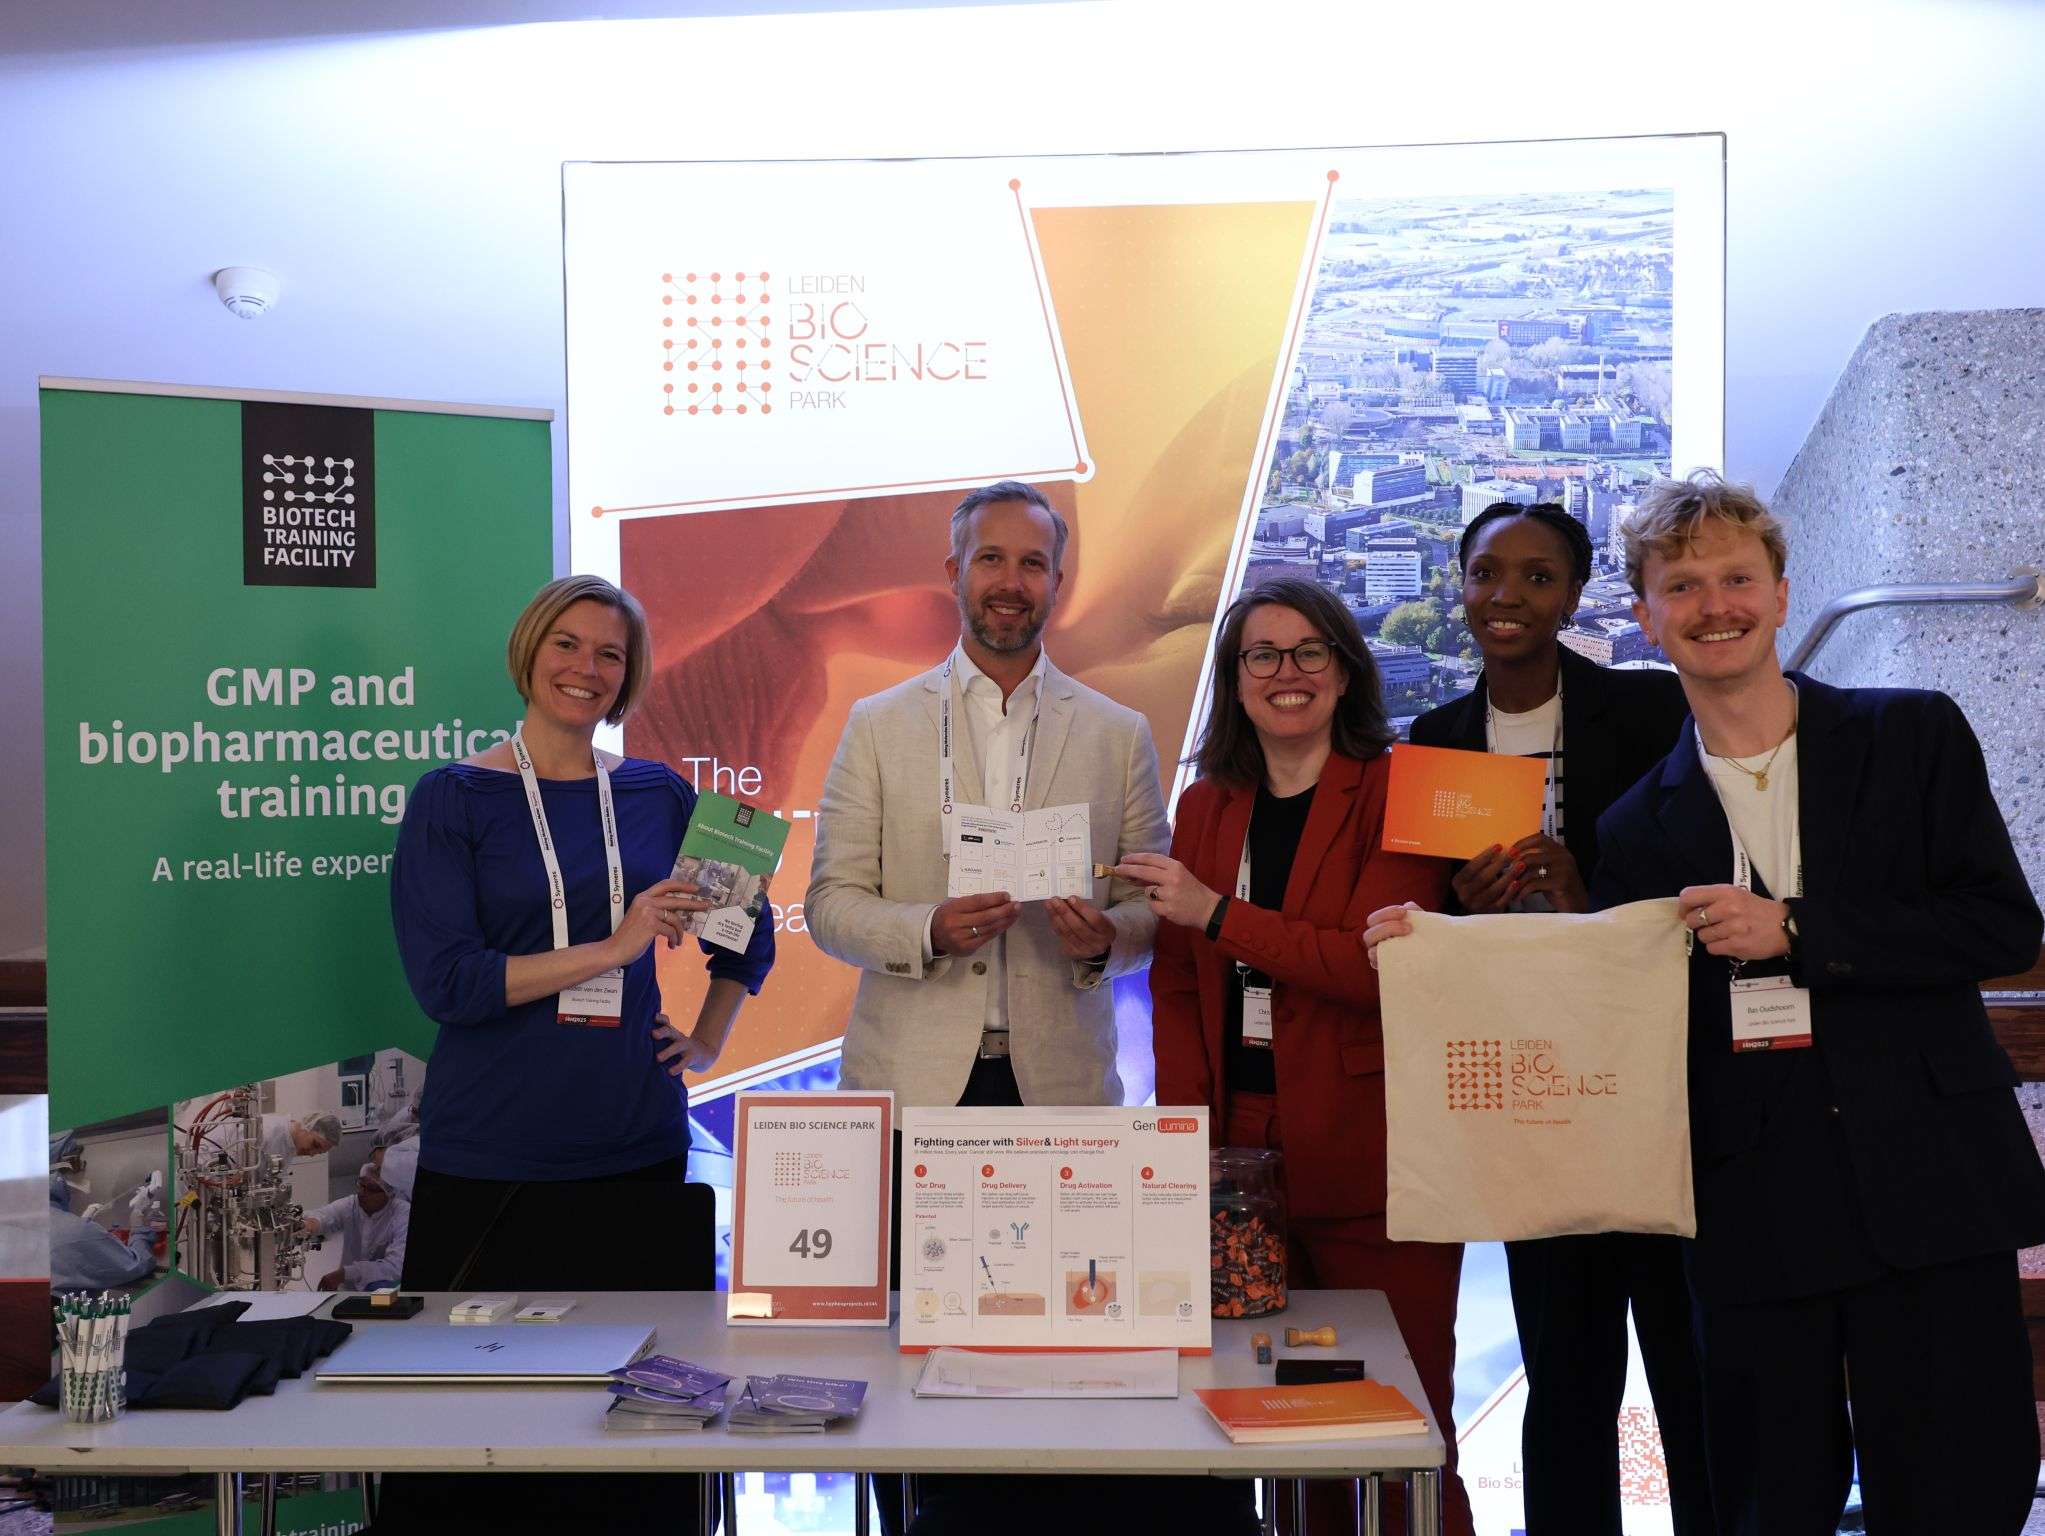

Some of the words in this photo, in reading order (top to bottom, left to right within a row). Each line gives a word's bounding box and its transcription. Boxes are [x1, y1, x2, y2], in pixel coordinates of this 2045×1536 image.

[788, 274, 865, 294] LEIDEN
[789, 301, 868, 340] BIO
[789, 342, 987, 382] SCIENCE
[790, 390, 846, 409] PARK
[263, 506, 356, 528] BIOTECH
[264, 528, 356, 546] TRAINING
[264, 547, 355, 568] FACILITY
[206, 667, 316, 706] GMP
[330, 666, 415, 706] and
[682, 757, 762, 796] The
[217, 773, 406, 824] training
[152, 857, 174, 882] A
[183, 851, 302, 880] real-life
[312, 848, 394, 880] exper
[553, 870, 561, 897] Symeres
[1510, 1040, 1552, 1050] LEIDEN
[1512, 1053, 1554, 1074] BIO
[1512, 1074, 1618, 1096] SCIENCE
[1512, 1100, 1544, 1110] PARK
[1133, 1120, 1156, 1131] Gen
[1160, 1121, 1195, 1131] Lumina
[914, 1138, 954, 1148] Fighting
[993, 1138, 1014, 1146] with
[1054, 1138, 1079, 1148] Light
[1082, 1139, 1120, 1148] surgery
[804, 1160, 823, 1169] BIO
[804, 1170, 850, 1179] SCIENCE
[790, 1228, 832, 1258] 49
[1478, 1477, 1500, 1489] Bio
